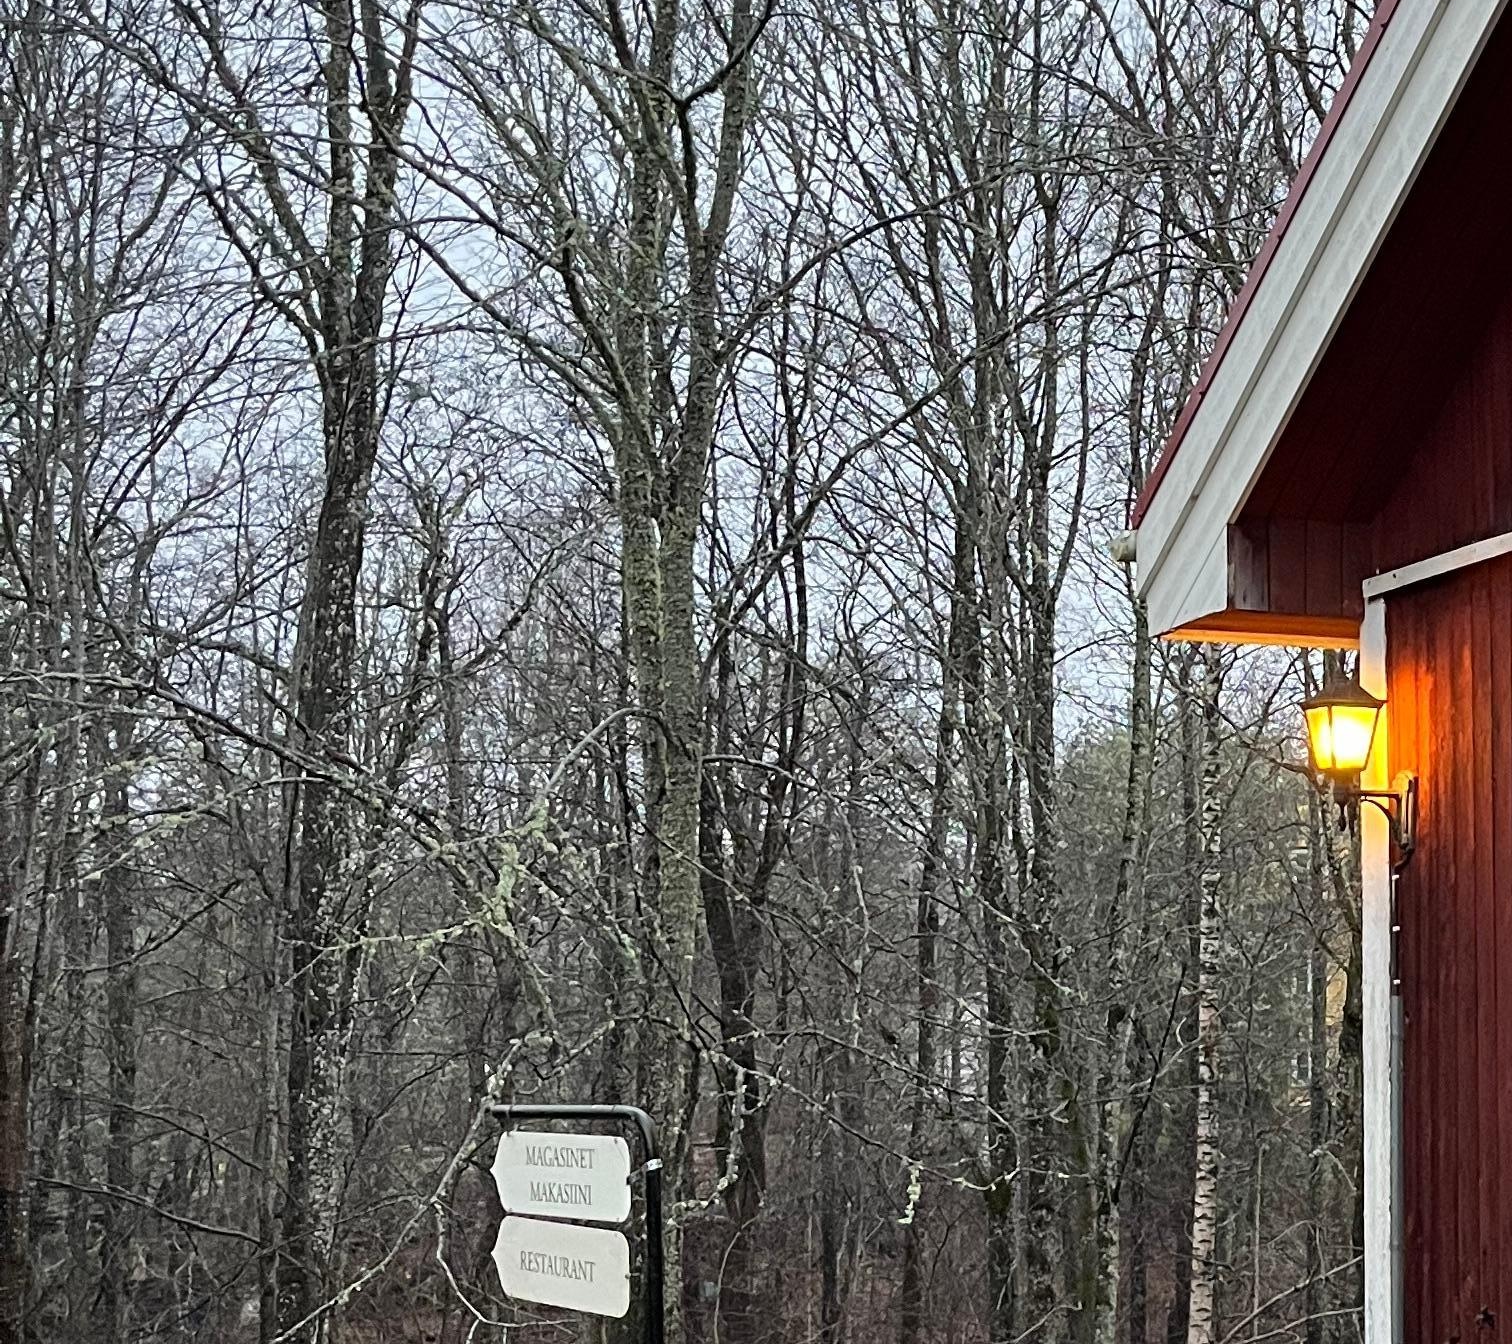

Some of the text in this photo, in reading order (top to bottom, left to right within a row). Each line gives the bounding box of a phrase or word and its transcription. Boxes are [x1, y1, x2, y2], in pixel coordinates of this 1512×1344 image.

[526, 1146, 595, 1169] MAGASINET
[530, 1181, 593, 1206] MAKASIINI
[520, 1250, 596, 1282] RESTAURANT
